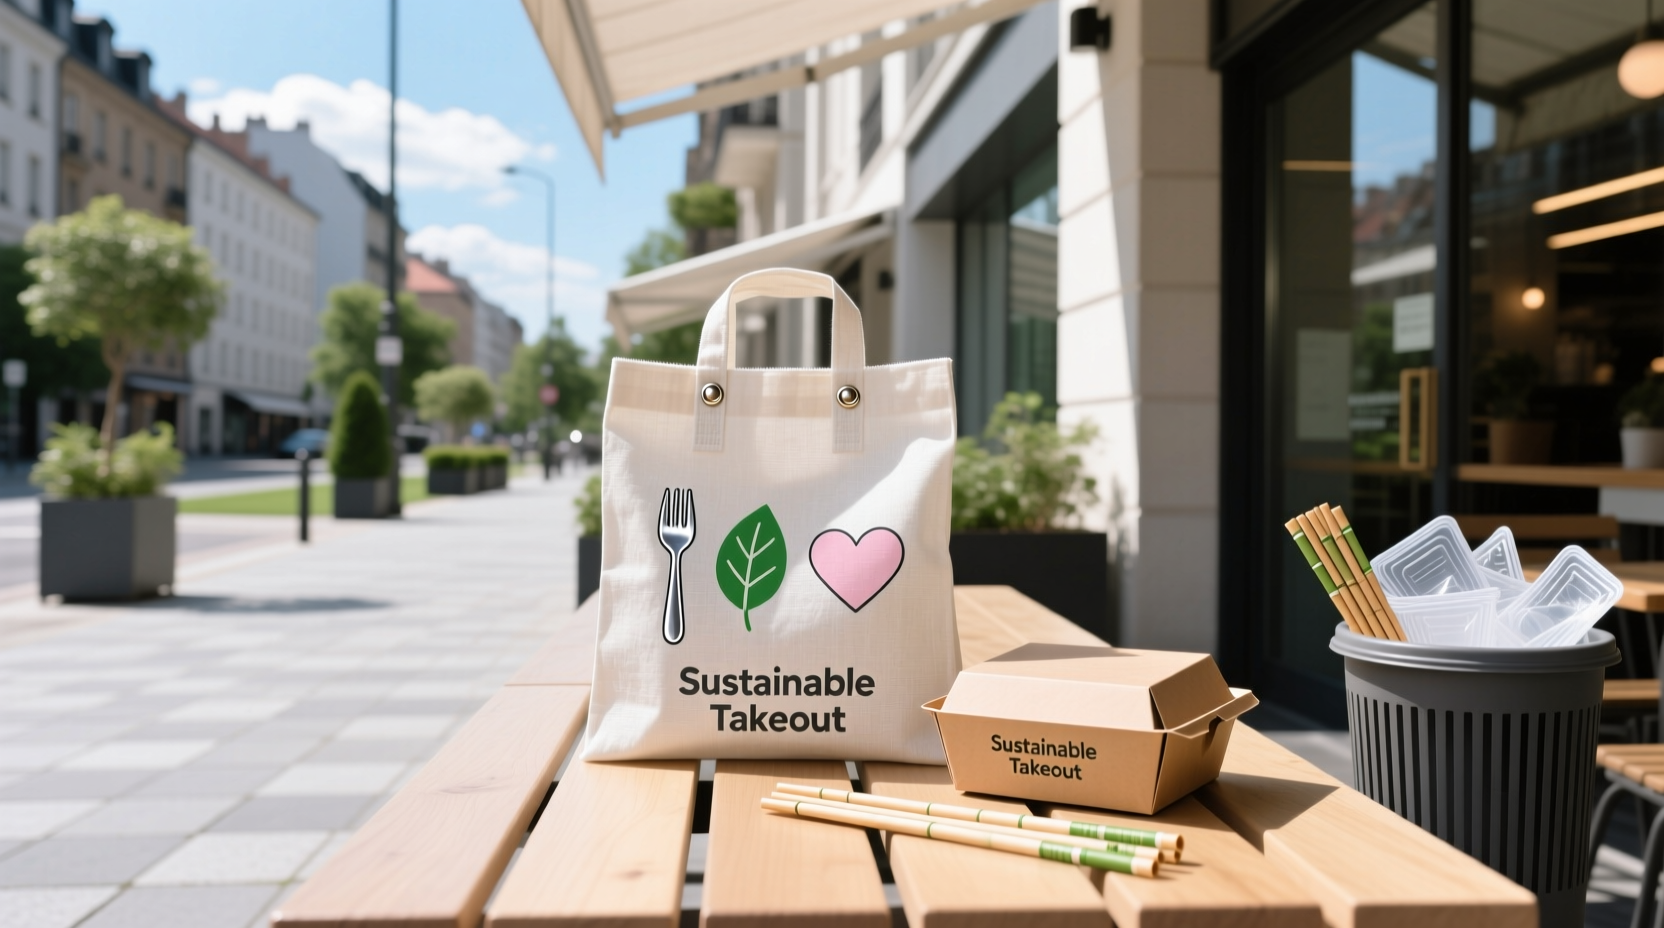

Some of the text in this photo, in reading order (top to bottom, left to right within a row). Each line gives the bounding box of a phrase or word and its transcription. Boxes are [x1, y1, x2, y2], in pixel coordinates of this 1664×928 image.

[678, 666, 876, 697] Sustainable
[709, 704, 847, 733] Takeout
[991, 734, 1097, 760] Sustainable
[1009, 757, 1082, 780] Takeout
